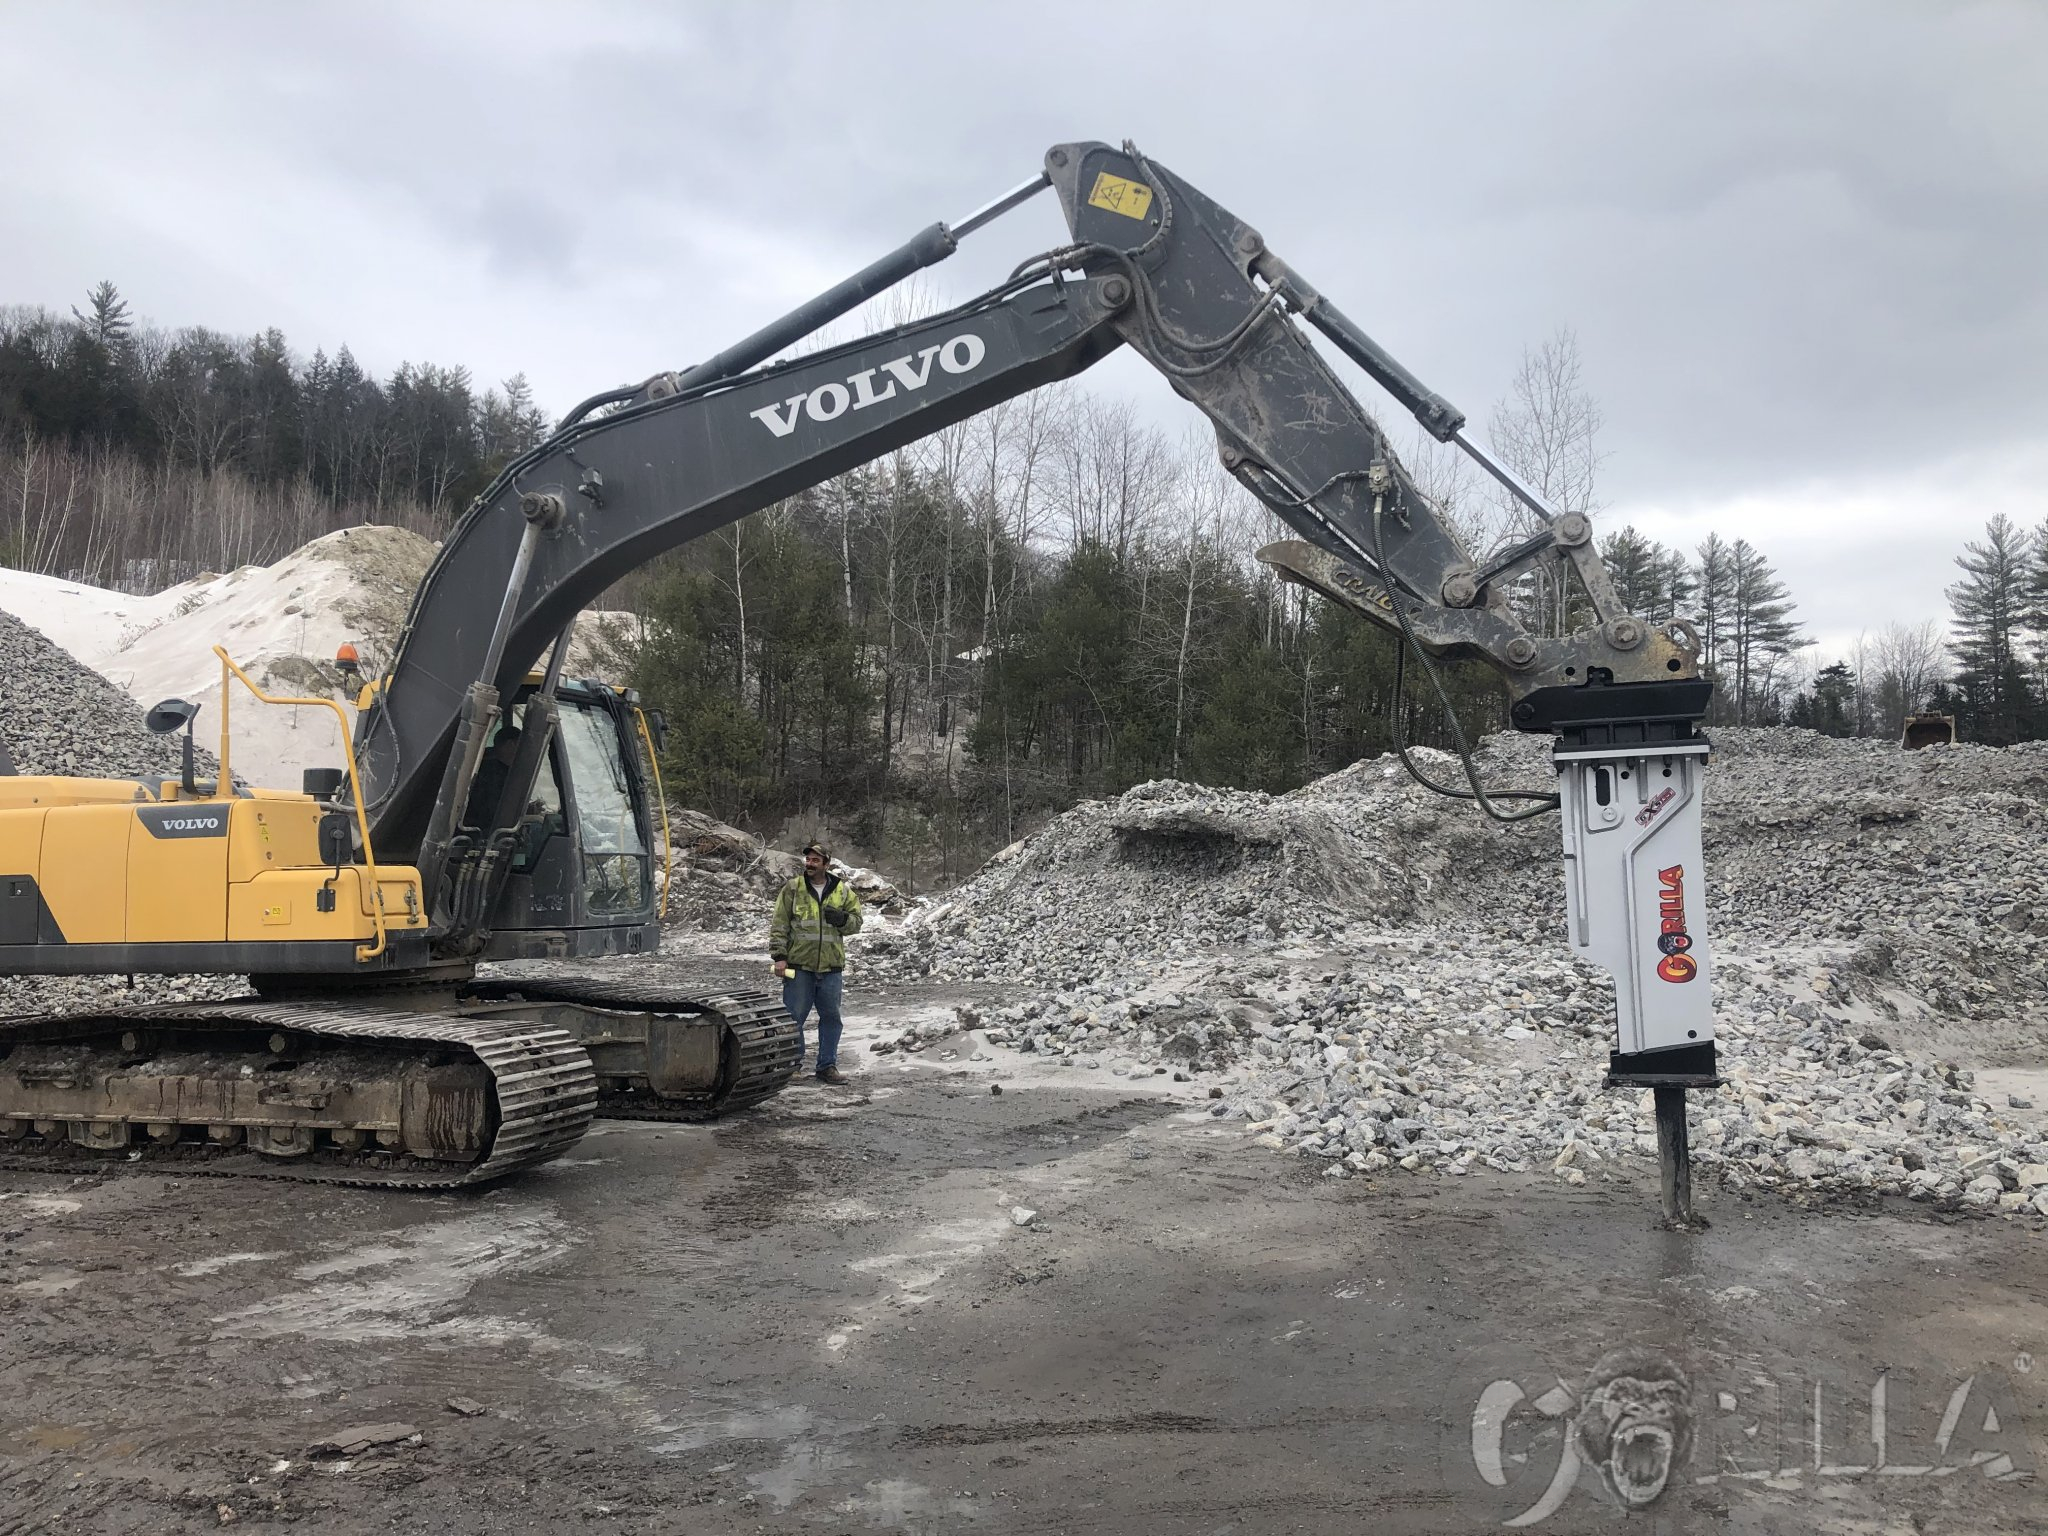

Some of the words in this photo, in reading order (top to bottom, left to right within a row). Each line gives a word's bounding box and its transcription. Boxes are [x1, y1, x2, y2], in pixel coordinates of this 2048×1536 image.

[750, 334, 985, 437] VOLVO
[162, 818, 219, 831] VOLVO
[1657, 864, 1697, 983] GORILLA
